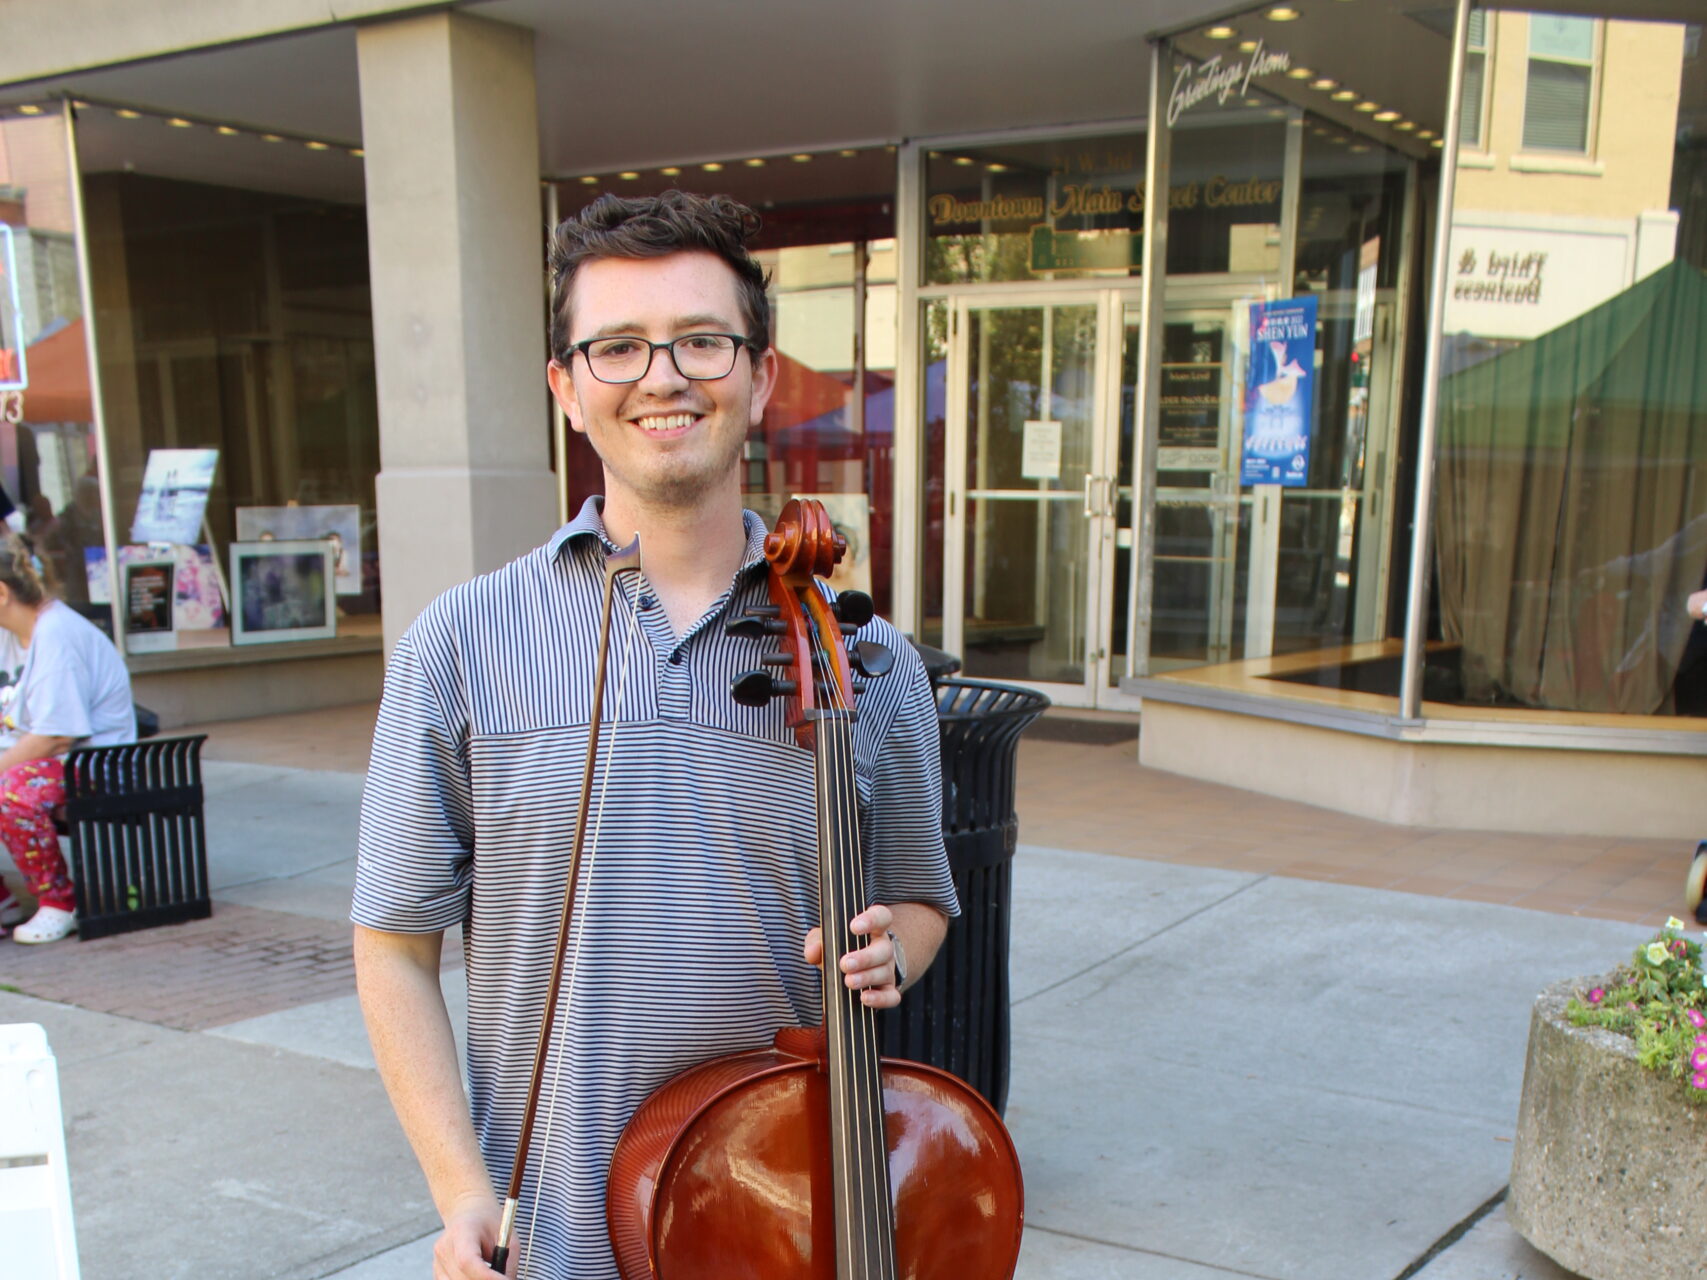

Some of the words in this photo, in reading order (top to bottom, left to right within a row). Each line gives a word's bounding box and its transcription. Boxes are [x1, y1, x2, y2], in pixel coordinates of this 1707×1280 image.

[1167, 54, 1242, 128] Greetings
[929, 193, 1044, 225] Downtown
[1050, 184, 1123, 216] Main
[1205, 175, 1282, 207] Center
[1257, 326, 1285, 341] SHEN
[1287, 322, 1308, 340] YUN
